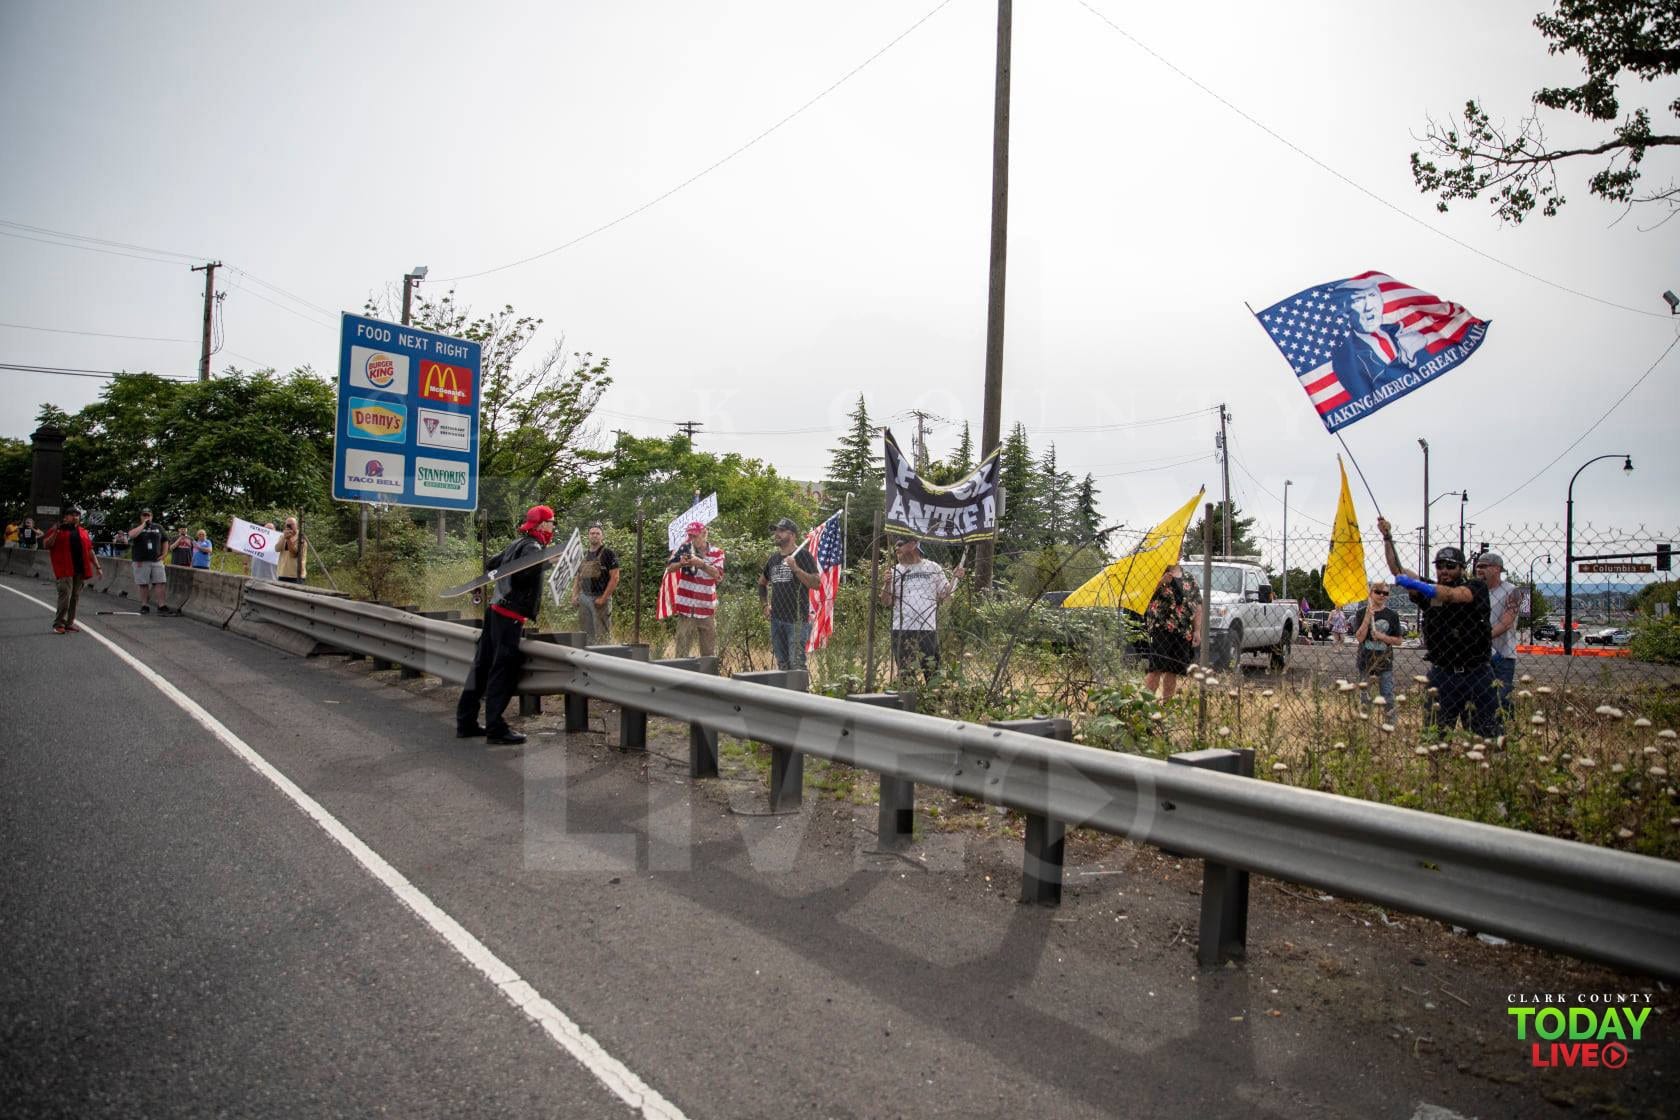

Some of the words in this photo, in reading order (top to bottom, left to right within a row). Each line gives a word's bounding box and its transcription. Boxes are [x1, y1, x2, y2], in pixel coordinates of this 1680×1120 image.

[357, 324, 392, 342] FOOD
[398, 333, 429, 349] NEXT
[436, 341, 469, 359] RIGHT
[368, 360, 393, 370] BURGER
[368, 367, 394, 379] KING
[429, 385, 465, 398] McDonald's
[1327, 394, 1375, 428] MAKING
[1371, 372, 1421, 404] AMERICA
[1418, 347, 1459, 379] GREAT
[356, 411, 401, 430] Denny's
[347, 475, 374, 484] TACO
[376, 478, 401, 487] BELL
[895, 453, 993, 500] FCK
[887, 493, 996, 537] ANTIFA
[1593, 564, 1637, 572] Columbia
